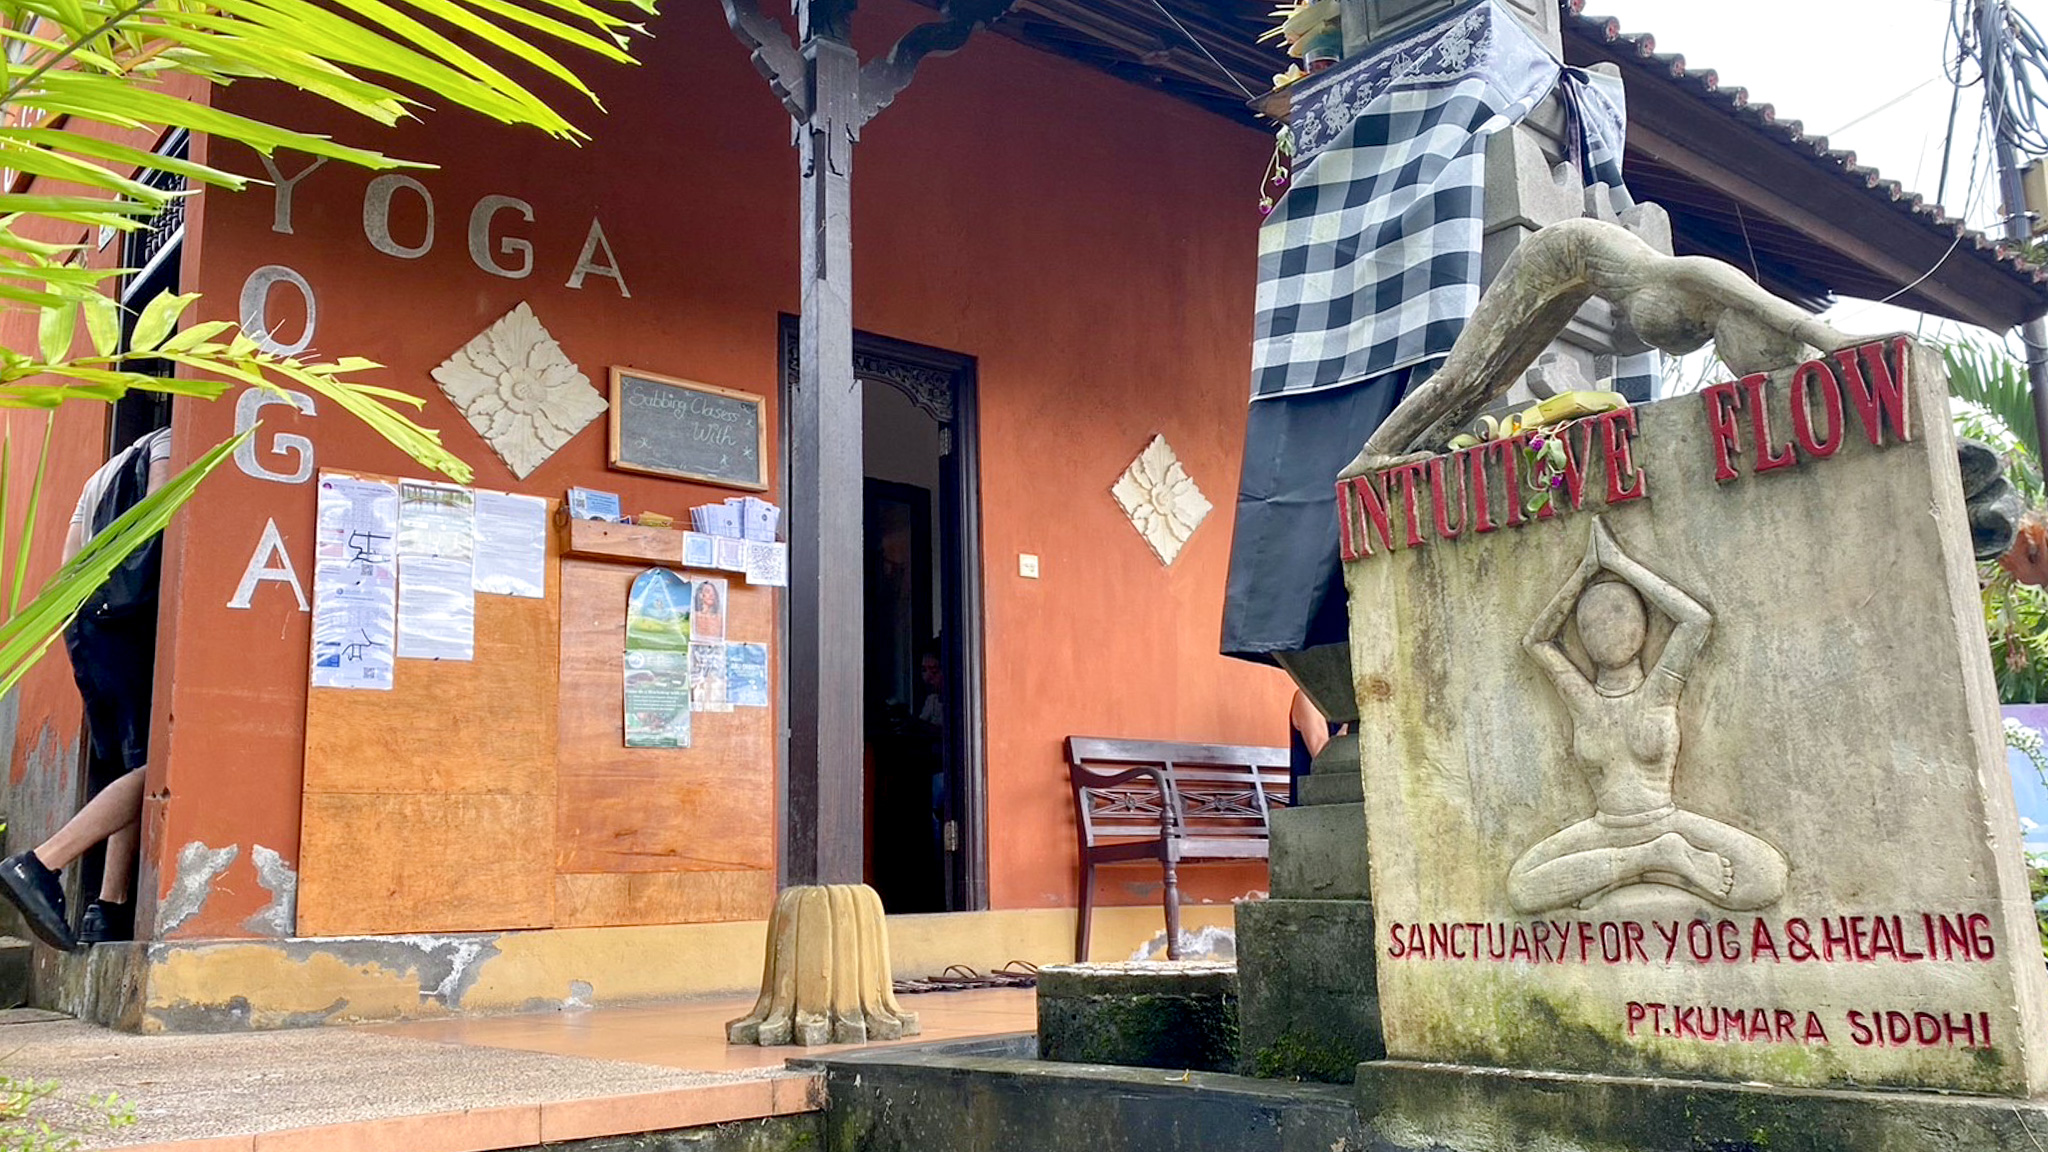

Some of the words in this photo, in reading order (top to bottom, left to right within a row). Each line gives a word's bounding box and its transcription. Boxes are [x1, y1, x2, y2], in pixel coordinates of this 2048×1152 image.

[257, 152, 631, 298] YOGA
[692, 421, 736, 446] With
[1702, 336, 1912, 484] FLOW
[1387, 920, 1571, 965] SANCTUARY
[1577, 920, 1650, 965] FOR
[1652, 917, 1781, 964] YOGA
[1784, 917, 1820, 964] &
[1820, 912, 1995, 963] HEALING
[1849, 1009, 1992, 1049] SIDDHI
